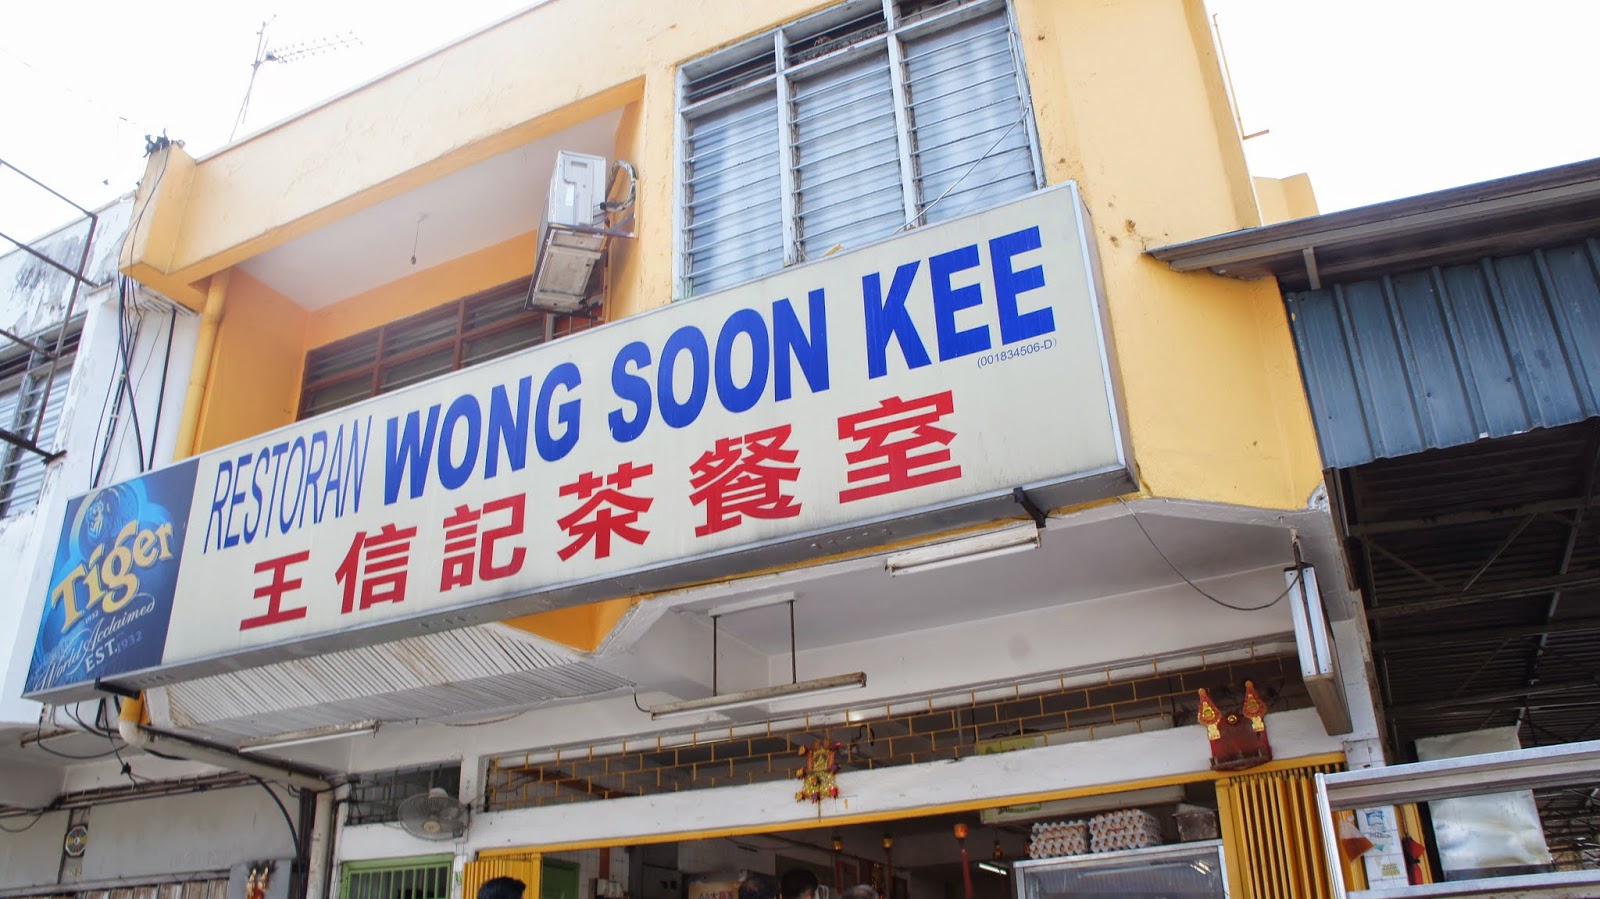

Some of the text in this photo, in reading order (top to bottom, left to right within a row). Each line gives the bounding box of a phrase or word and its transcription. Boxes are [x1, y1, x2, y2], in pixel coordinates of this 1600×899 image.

[203, 225, 1056, 554] RESTORAN WONG SOON KEE
[977, 336, 1057, 369] (001834506-D)
[241, 391, 961, 629] 王信記茶餐室
[51, 520, 174, 633] Tiger
[34, 593, 155, 692] World Acclaimed
